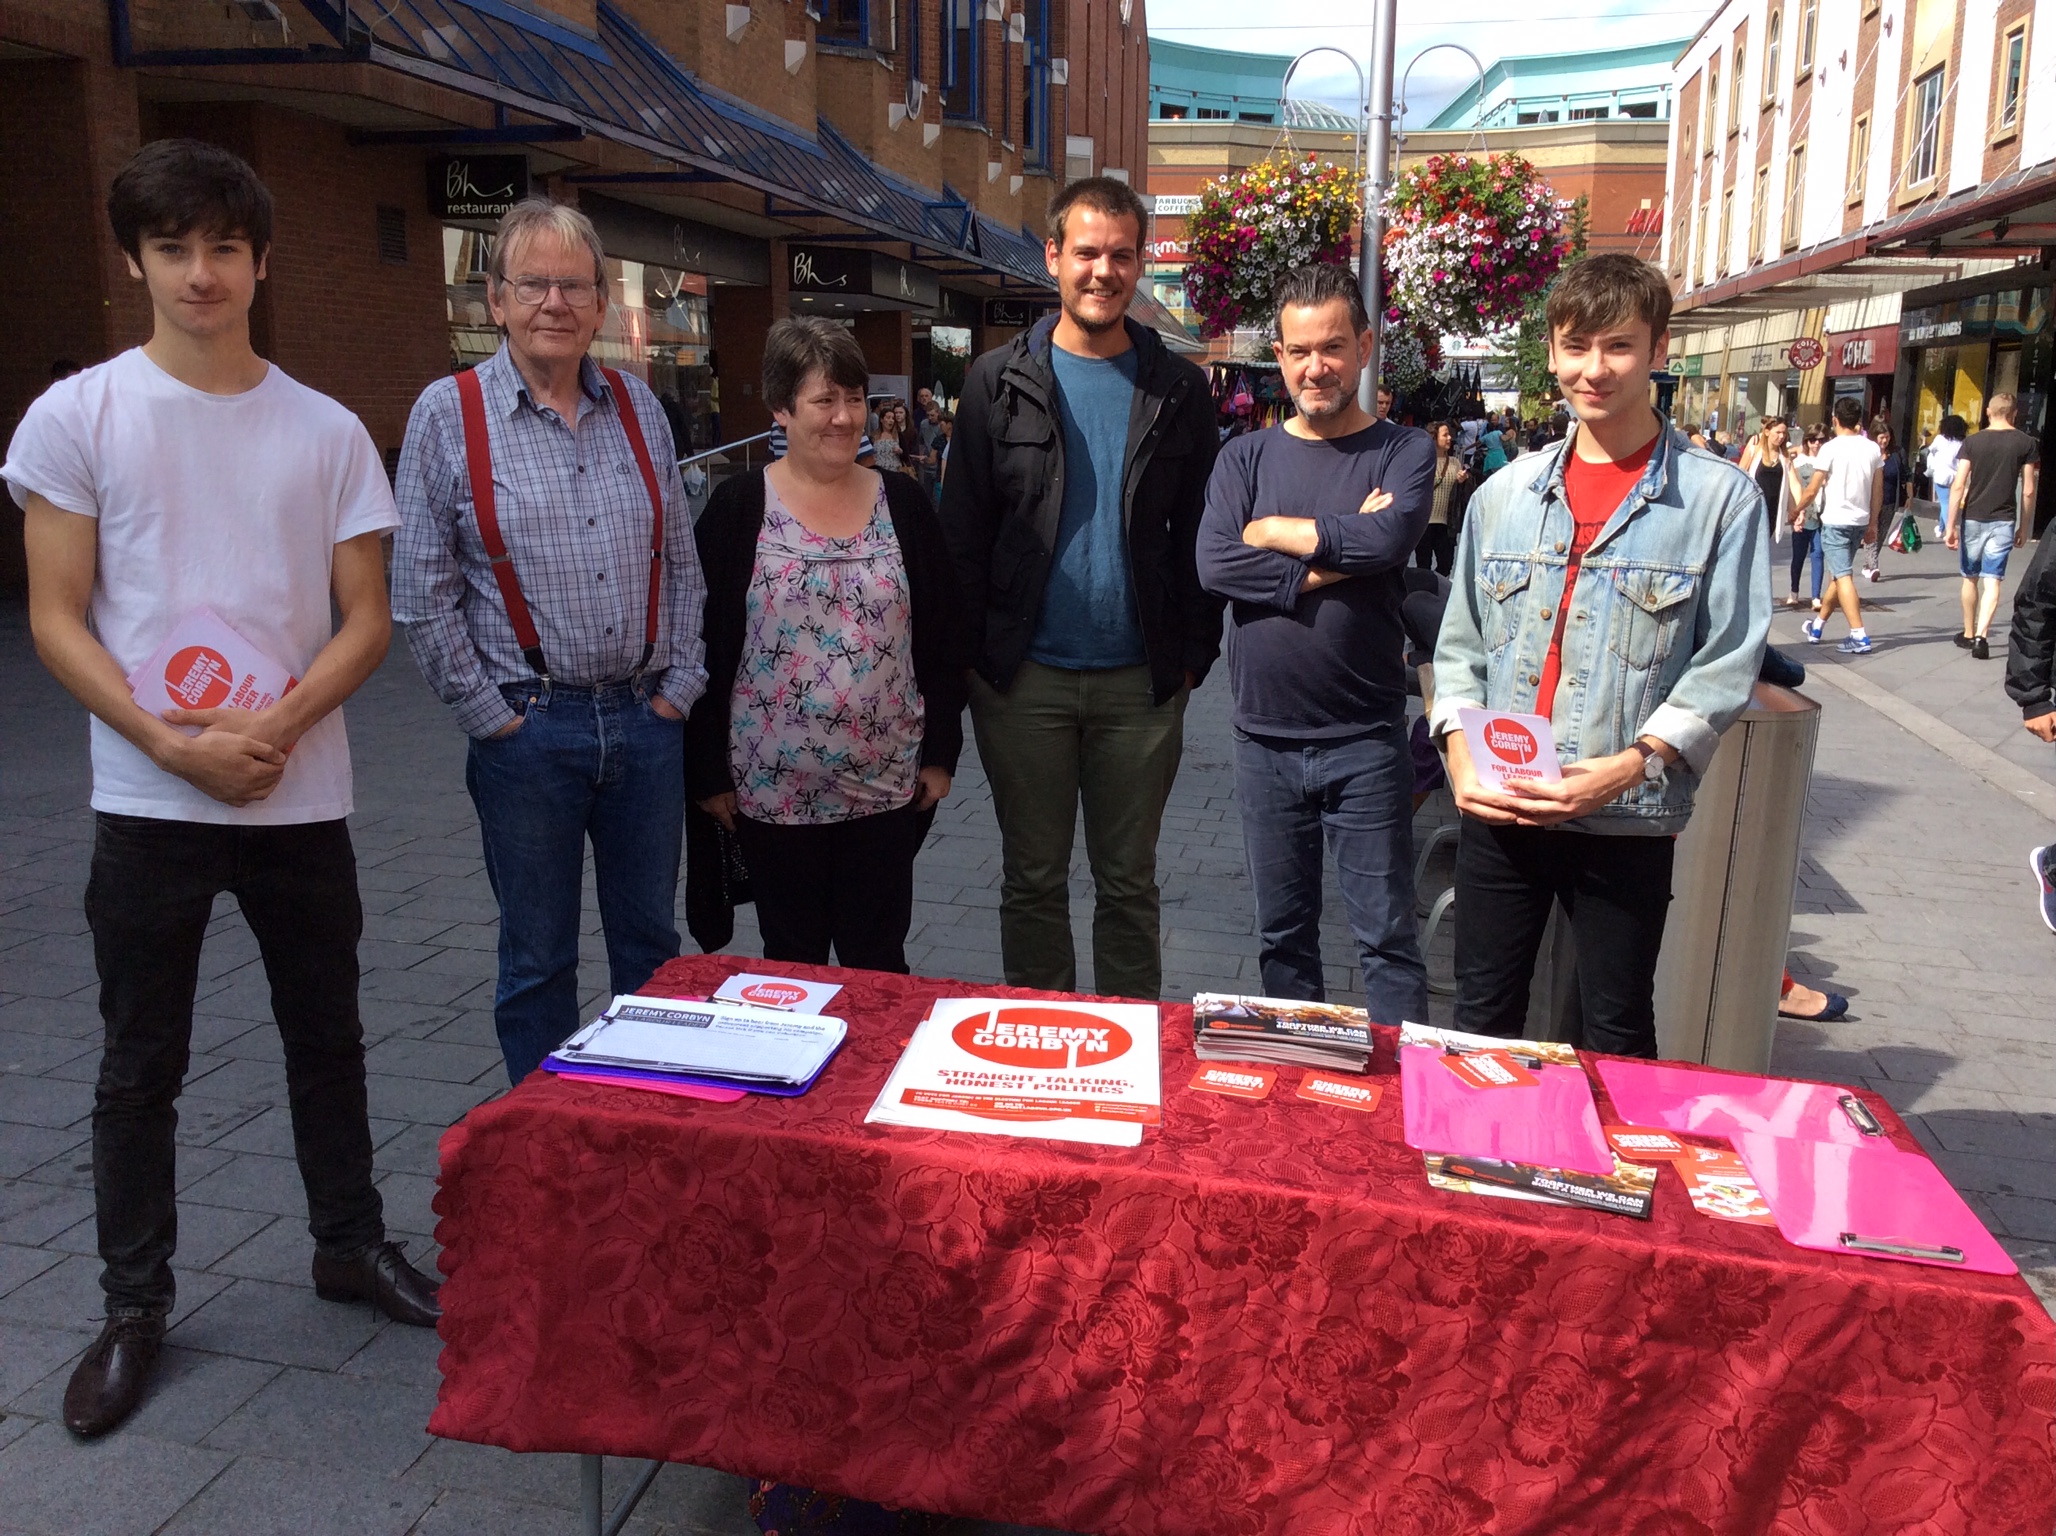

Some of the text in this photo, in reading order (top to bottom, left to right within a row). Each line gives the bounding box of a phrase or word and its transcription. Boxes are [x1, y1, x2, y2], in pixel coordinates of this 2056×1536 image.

[446, 160, 515, 198] Bhs
[447, 203, 514, 214] restaurant
[794, 252, 848, 287] Bhs
[1796, 340, 1818, 350] COSTA
[1793, 356, 1820, 368] COFFEE
[165, 651, 211, 699] JEREMY
[186, 659, 233, 706] CORBYN
[1490, 720, 1529, 744] JEREMY
[1490, 739, 1532, 764] CORBYN
[1491, 764, 1544, 777] FOR LABOUR
[622, 1007, 711, 1022] JEREMY CORBYN
[975, 1010, 1110, 1041] JEREMY
[972, 1033, 1109, 1069] CORBYN
[937, 1070, 1135, 1089] STRAIGHT TALKING,
[944, 1078, 1125, 1095] HONEST POLITICS
